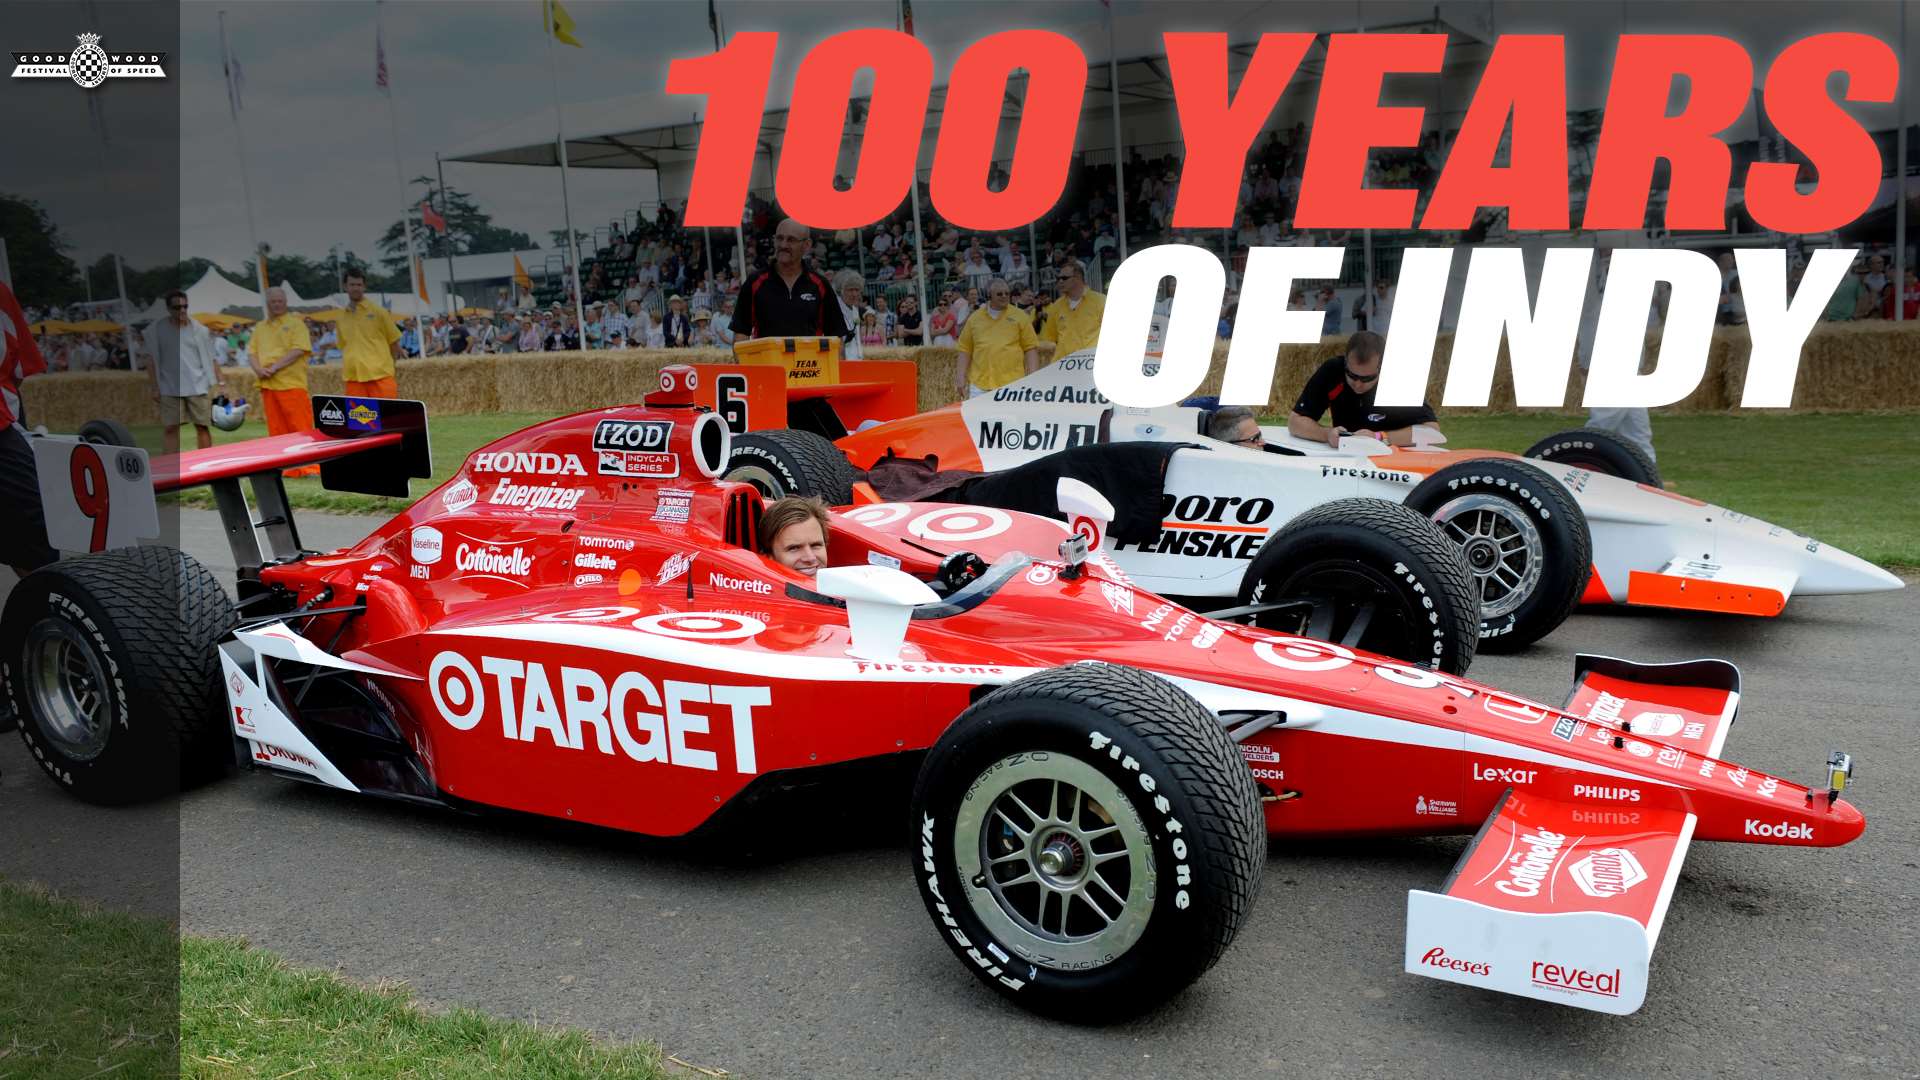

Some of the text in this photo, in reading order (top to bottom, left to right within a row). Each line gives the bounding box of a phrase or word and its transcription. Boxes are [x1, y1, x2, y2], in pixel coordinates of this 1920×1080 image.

[716, 374, 748, 434] 6
[993, 386, 1057, 402] United
[321, 409, 343, 420] PEAK
[598, 423, 663, 447] IZOD
[979, 421, 1059, 451] Mobil
[120, 455, 140, 474] 160
[474, 452, 588, 476] HONDA
[627, 455, 670, 463] INDYCAR
[627, 464, 663, 472] SERIES
[1320, 464, 1410, 483] Firestone
[69, 443, 110, 553] 9
[488, 478, 585, 512] Energizer
[1448, 475, 1551, 520] Firestone
[412, 538, 440, 550] Vaseline
[456, 543, 531, 576] Cottonelle
[574, 553, 617, 570] Gillette
[410, 564, 430, 580] MEN
[709, 572, 772, 594] Nicorette
[49, 592, 129, 731] FIREHAWK
[853, 660, 1004, 674] Firestone
[482, 655, 772, 775] TARGET
[965, 762, 1004, 802] RACING
[1473, 763, 1538, 784] Lexar
[1573, 784, 1641, 802] PHILIPS
[1089, 731, 1191, 910] Firestone
[1745, 819, 1813, 840] Kodak
[1494, 828, 1566, 897] Cottonelle
[1590, 850, 1627, 893] CLOROX
[923, 810, 1026, 992] FIREHAWK
[1061, 953, 1115, 969] RACING
[1421, 947, 1493, 976] Reese's
[1531, 960, 1620, 995] reveal
